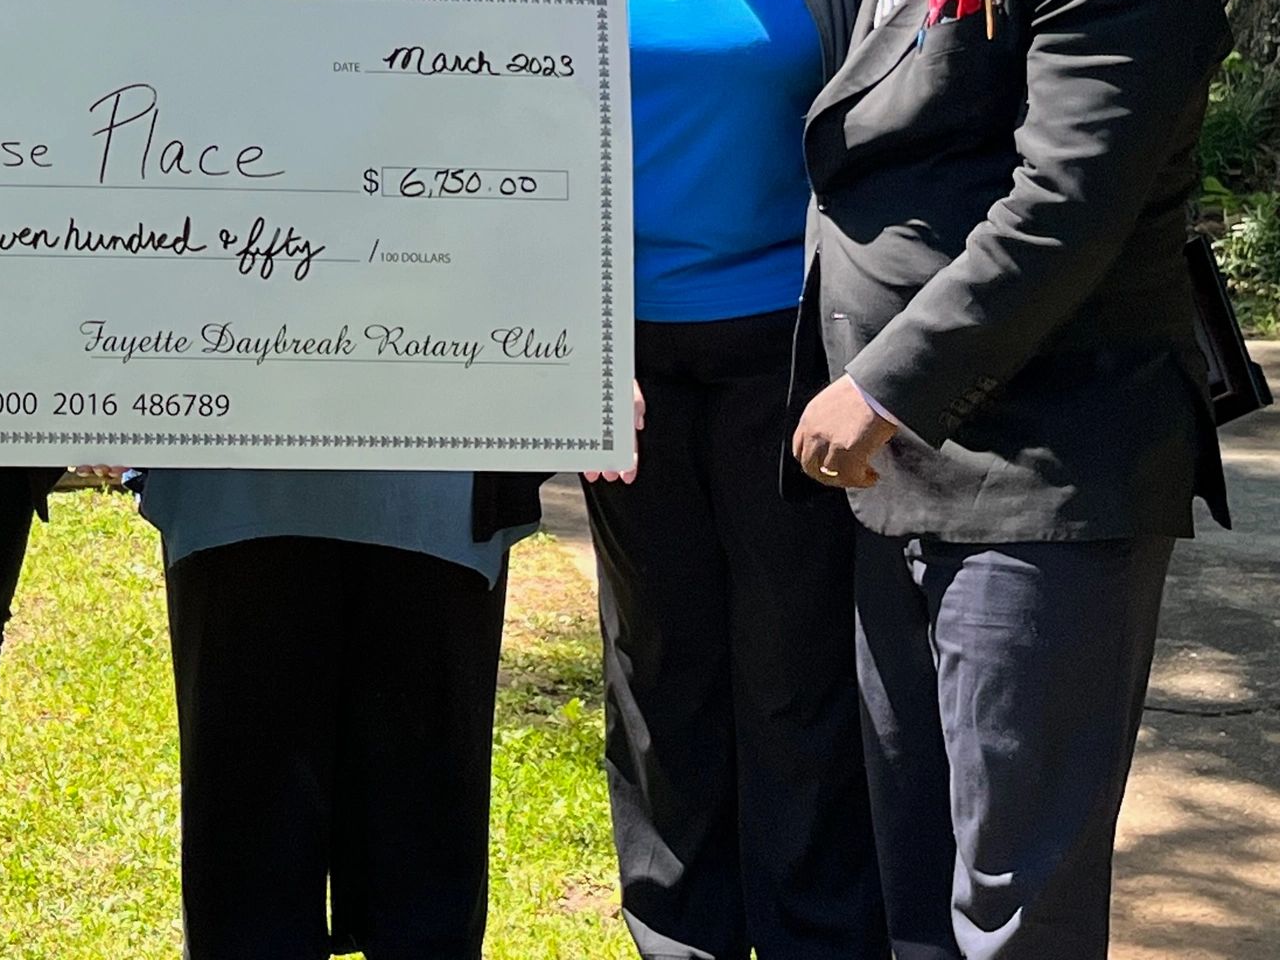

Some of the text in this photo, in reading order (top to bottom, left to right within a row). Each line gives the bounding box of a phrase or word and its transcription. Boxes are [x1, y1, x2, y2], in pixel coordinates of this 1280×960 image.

[332, 61, 361, 73] DATE
[383, 46, 575, 78] March 2023
[89, 83, 285, 185] Place
[64, 215, 207, 255] hundred
[401, 252, 452, 264] DOLLARS
[79, 320, 574, 369] Fayette Daybreak Rotary Club
[52, 392, 118, 416] 2016
[131, 392, 231, 417] 486789
